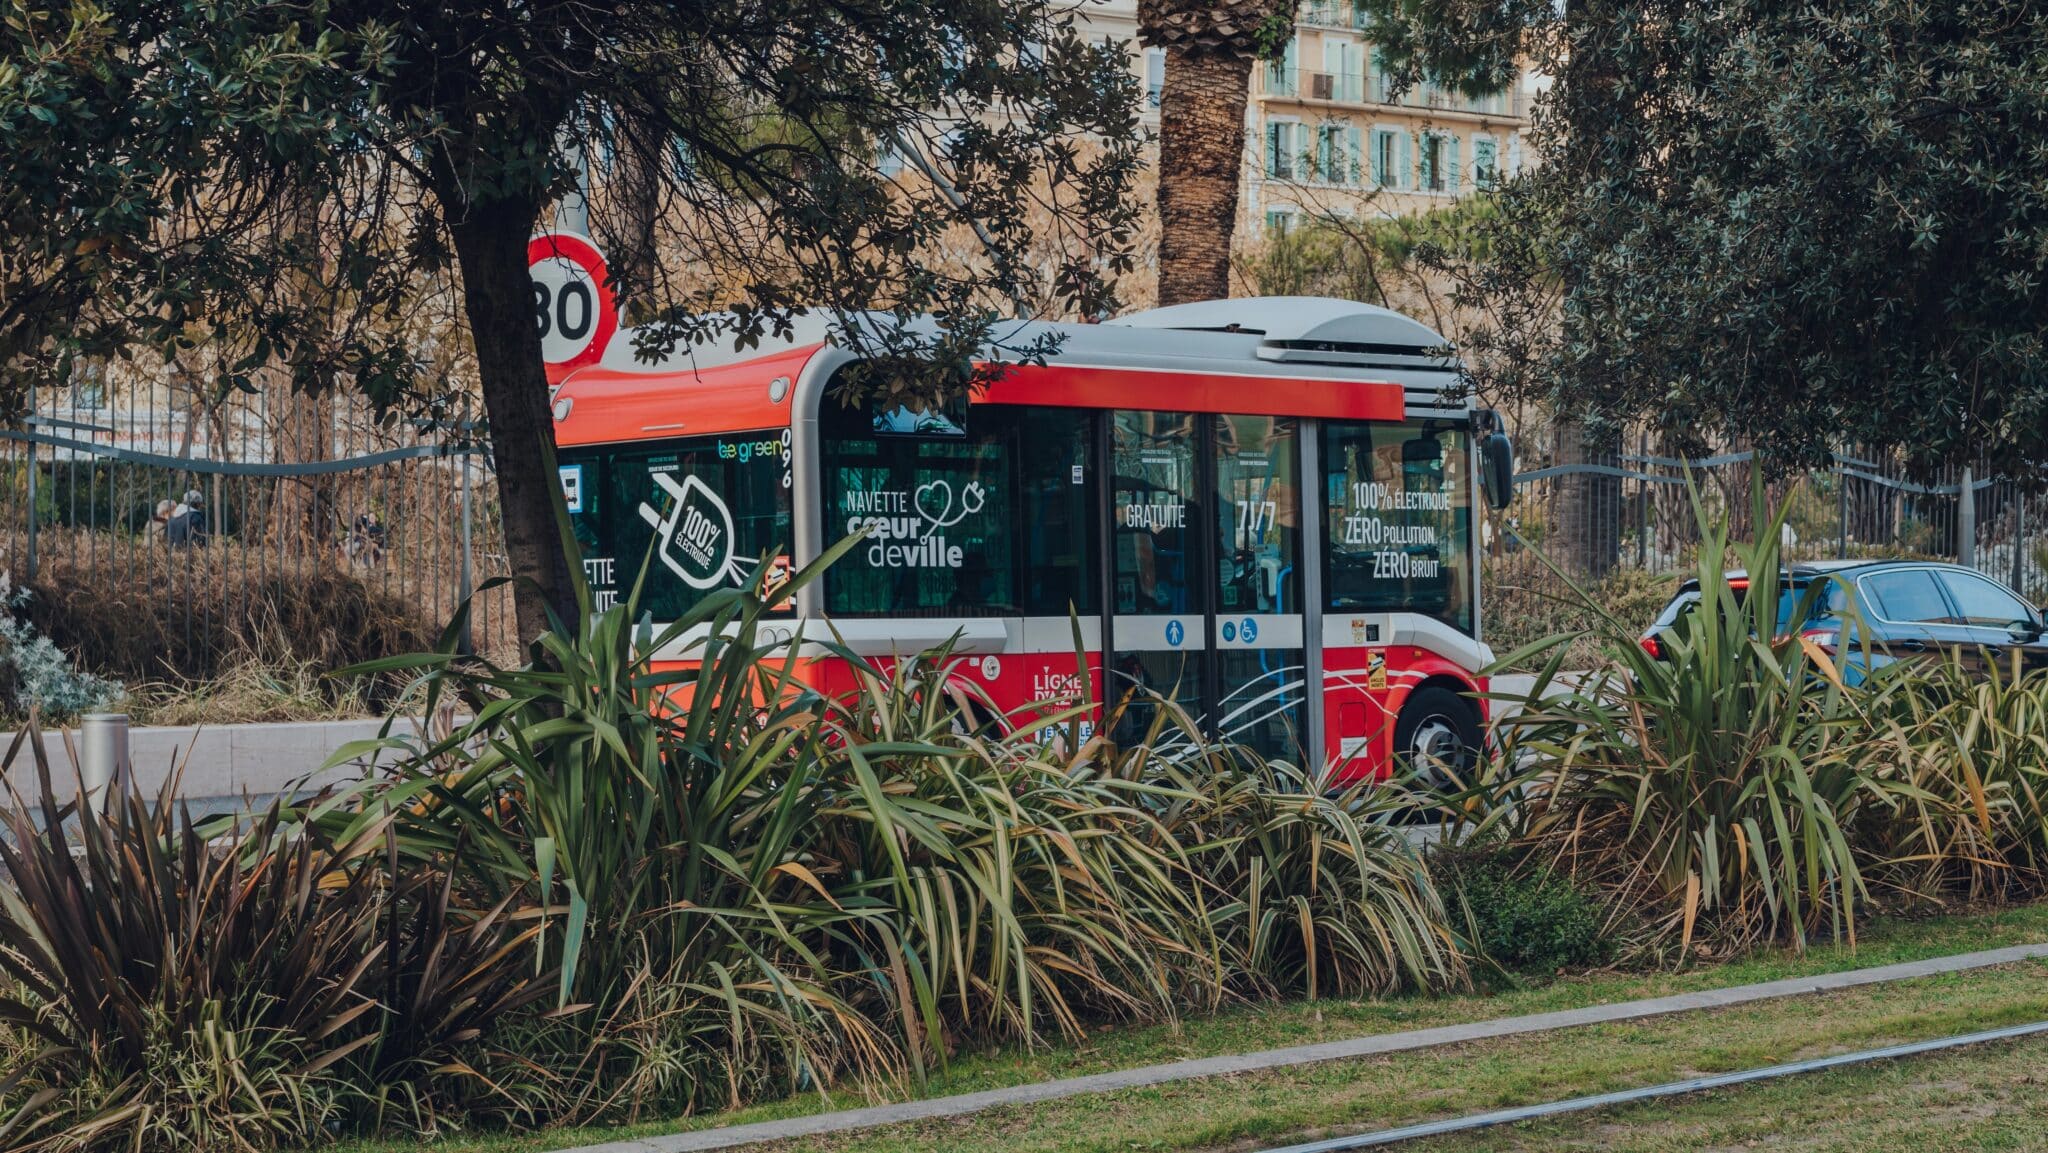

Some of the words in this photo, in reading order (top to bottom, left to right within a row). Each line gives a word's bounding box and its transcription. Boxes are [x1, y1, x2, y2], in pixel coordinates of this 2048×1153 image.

[738, 440, 783, 463] green
[781, 428, 792, 489] 096
[846, 490, 908, 513] NAVETTE
[1352, 482, 1392, 510] 100%
[1394, 488, 1450, 510] ÉLECTRIQUE
[1125, 503, 1186, 529] GRATUITE
[1344, 511, 1381, 544] ZÉRO
[1383, 526, 1435, 544] POLLUTION
[682, 505, 721, 557] 100%
[583, 558, 616, 585] ETTE
[1372, 546, 1409, 579] ZÉRO
[1411, 560, 1439, 578] BRUIT
